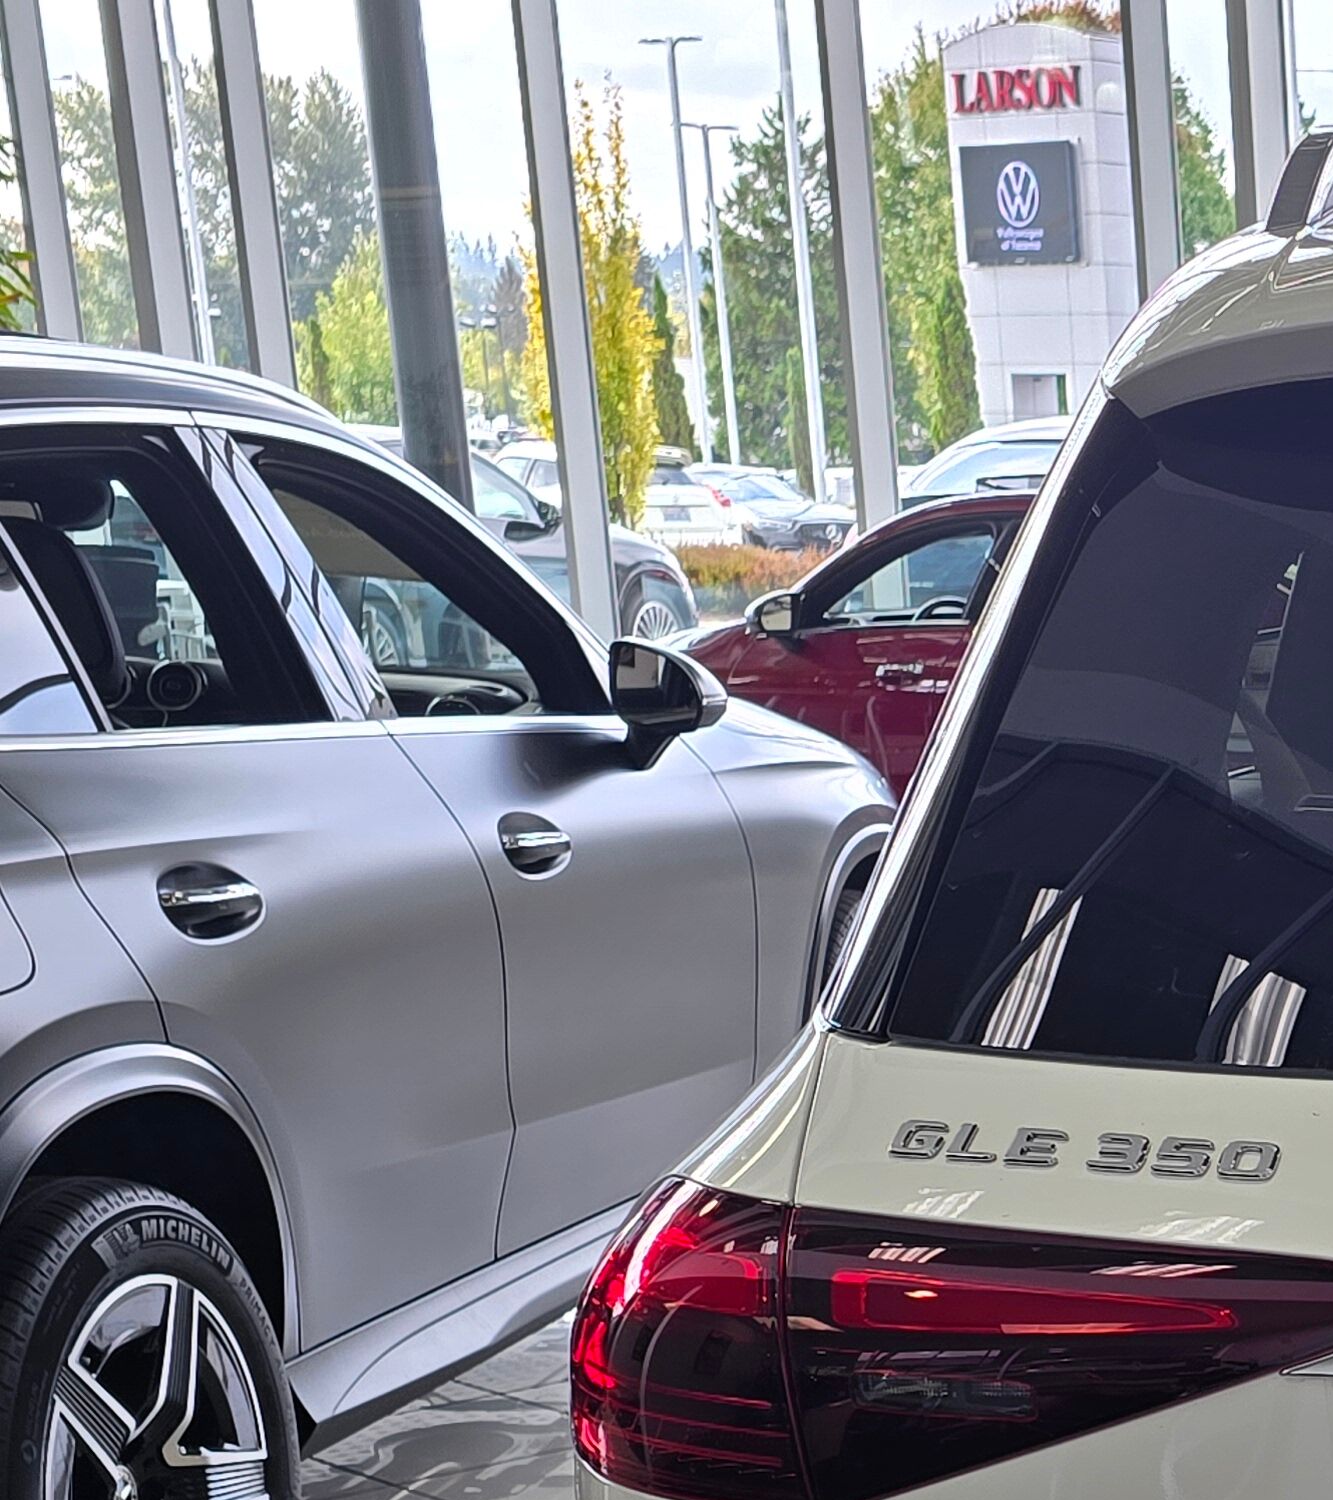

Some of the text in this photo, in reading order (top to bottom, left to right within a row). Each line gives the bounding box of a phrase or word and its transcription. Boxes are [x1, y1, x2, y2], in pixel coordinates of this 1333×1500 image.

[951, 65, 1081, 113] LARSON
[888, 1119, 1282, 1182] GLE 350
[141, 1217, 232, 1270] MICHELIN
